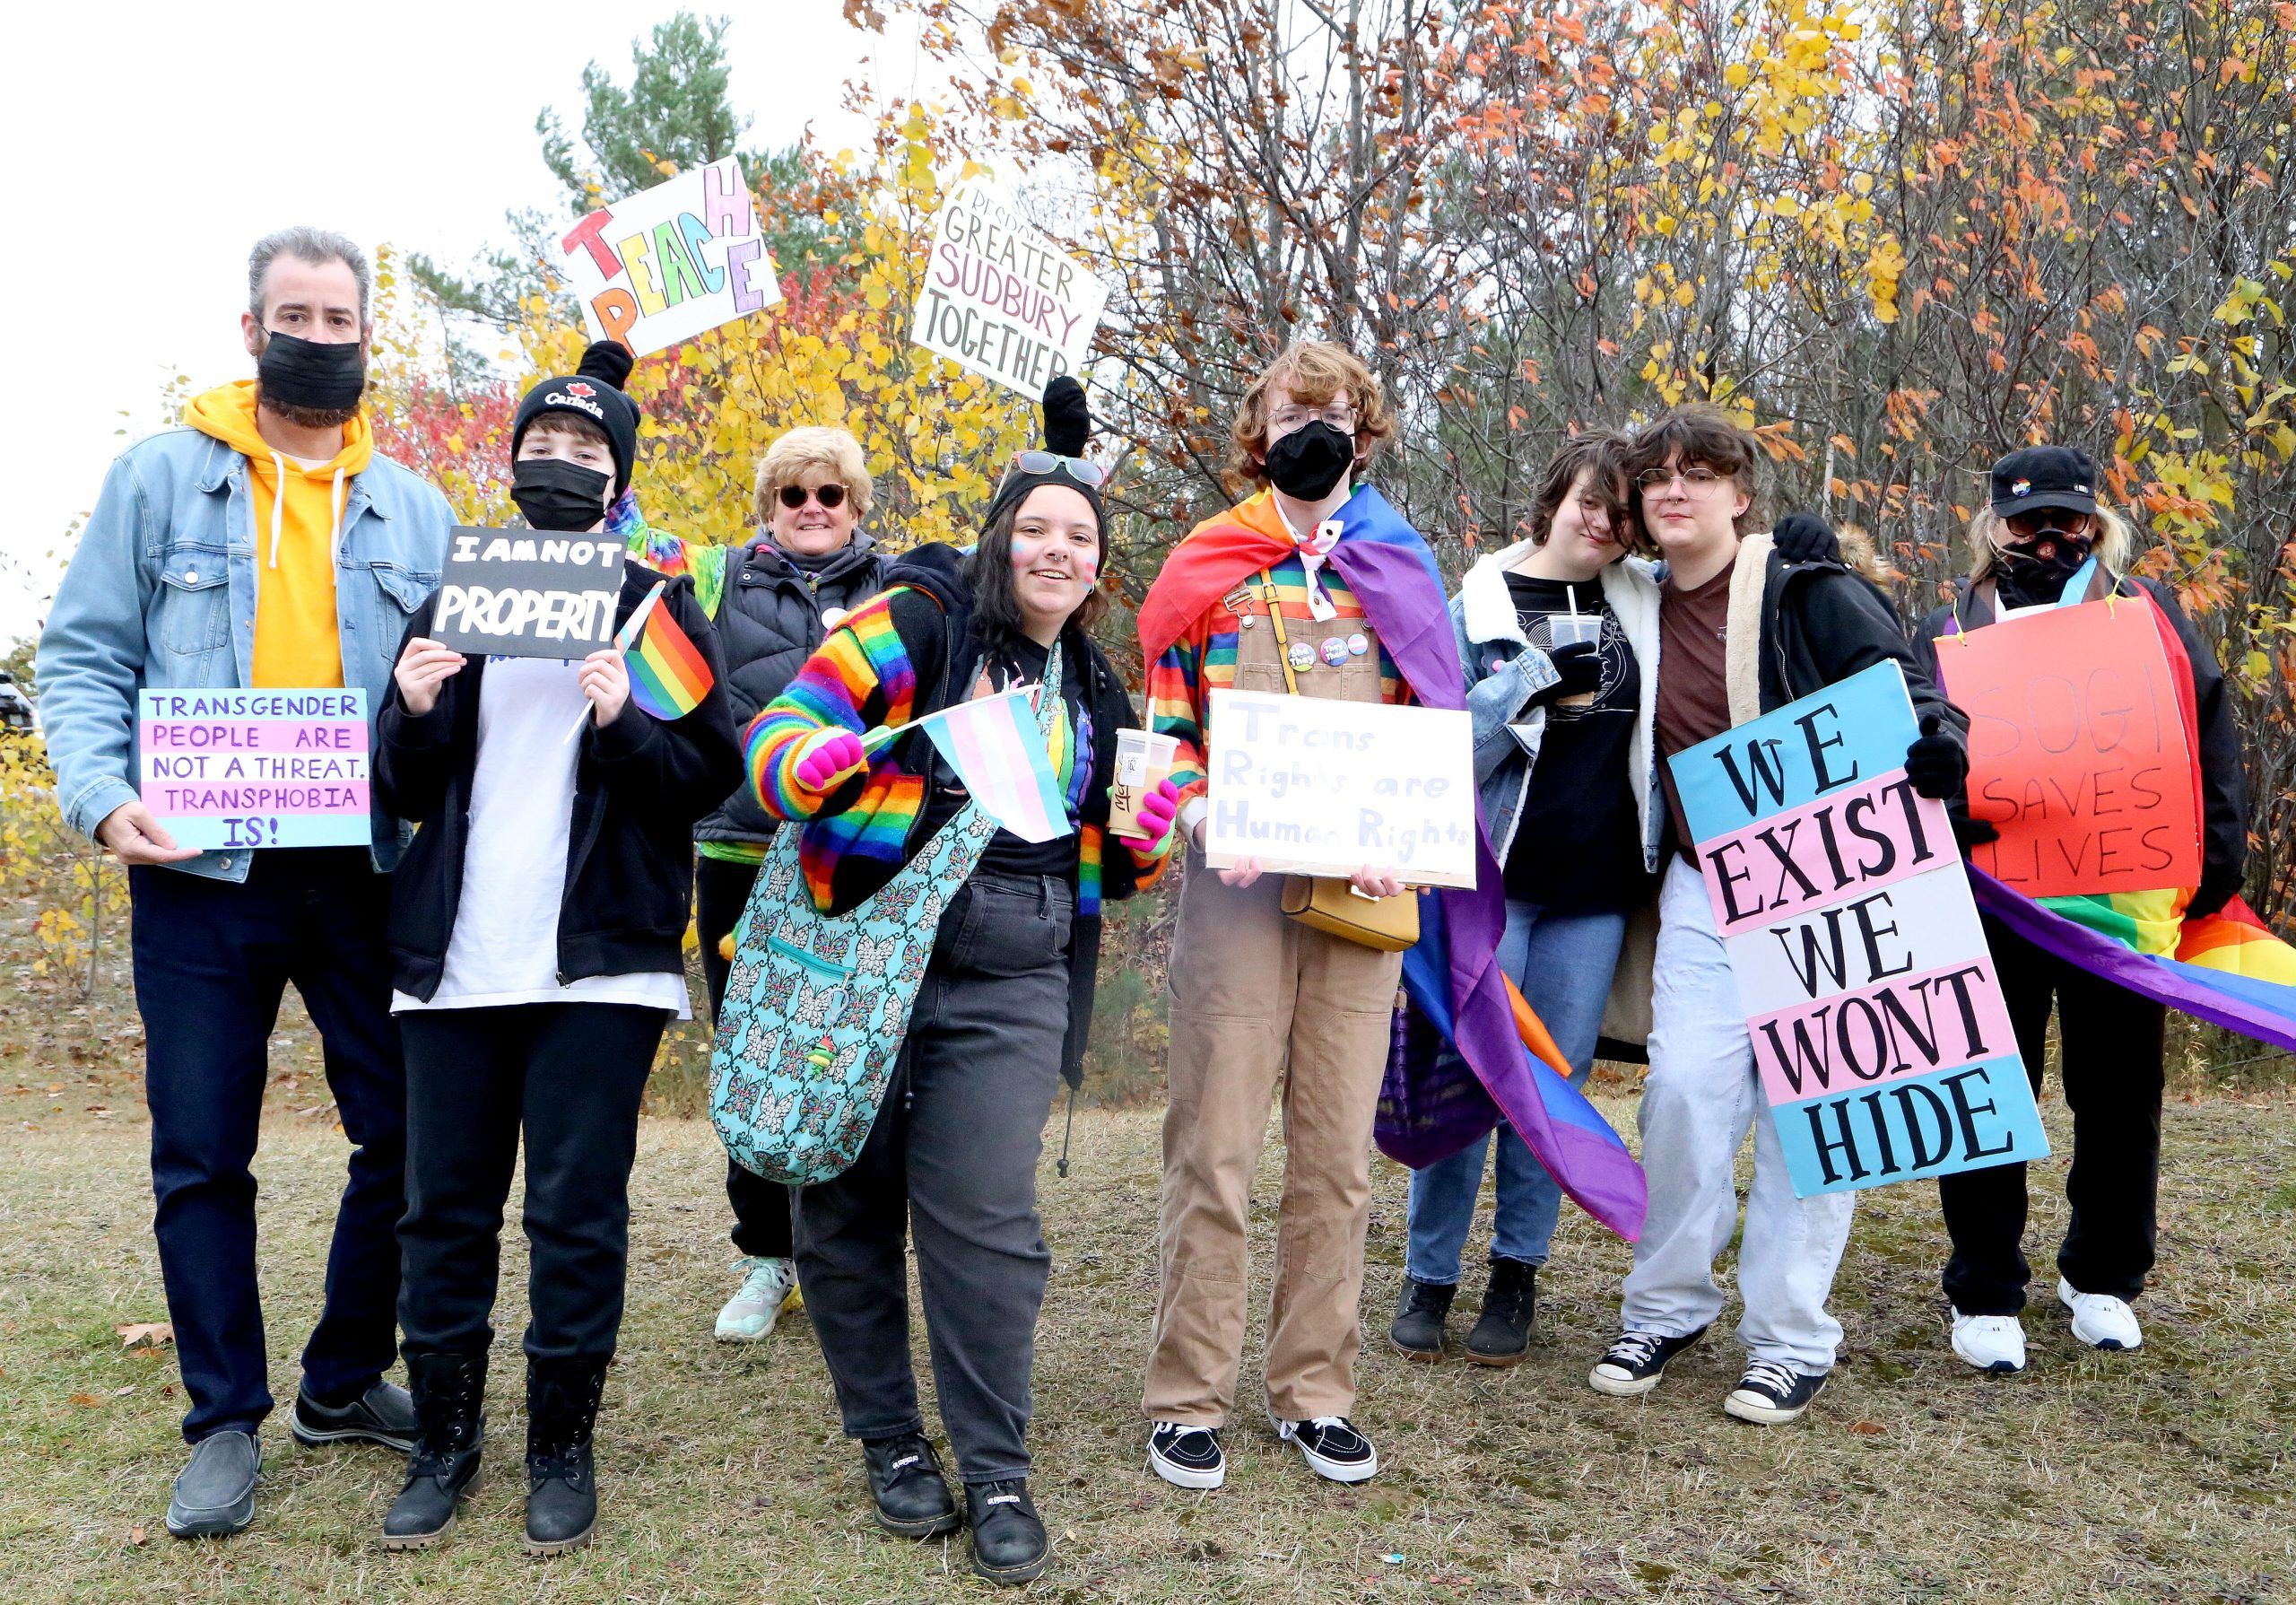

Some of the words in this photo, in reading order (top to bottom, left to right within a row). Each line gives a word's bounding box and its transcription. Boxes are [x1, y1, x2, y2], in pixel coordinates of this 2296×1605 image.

[561, 166, 751, 318] TEACH
[945, 205, 1074, 302] GREATER
[935, 243, 1083, 347] SUDBURY
[926, 287, 1069, 391] TOGETHER
[544, 392, 604, 419] Canada
[452, 536, 481, 563] I
[481, 538, 538, 563] AM
[540, 539, 622, 567] NOT
[434, 585, 621, 642] PROPERTY
[1289, 655, 1315, 667] They
[149, 695, 358, 717] TRANSGENDER
[1229, 701, 1377, 752] Trans
[1970, 664, 2161, 757] SOGI
[153, 725, 259, 747] PEOPLE
[295, 727, 352, 749] ARE
[1713, 702, 1858, 817] WE
[153, 755, 211, 779] NOT
[224, 756, 245, 779] A
[255, 757, 365, 780] THREAT.
[1222, 748, 1349, 799] Righs
[1374, 775, 1450, 798] are
[1982, 767, 2162, 823] SAVES
[165, 788, 358, 811] TRANSPHOBIA
[222, 816, 278, 847] IS!
[1215, 799, 1342, 845] Human
[1358, 807, 1470, 863] Rights
[1706, 779, 1935, 926] EXIST
[1991, 825, 2173, 882] LIVES
[1770, 891, 1912, 999] WE
[1759, 965, 1989, 1095] WONT
[1803, 1067, 2013, 1186] HIDE
